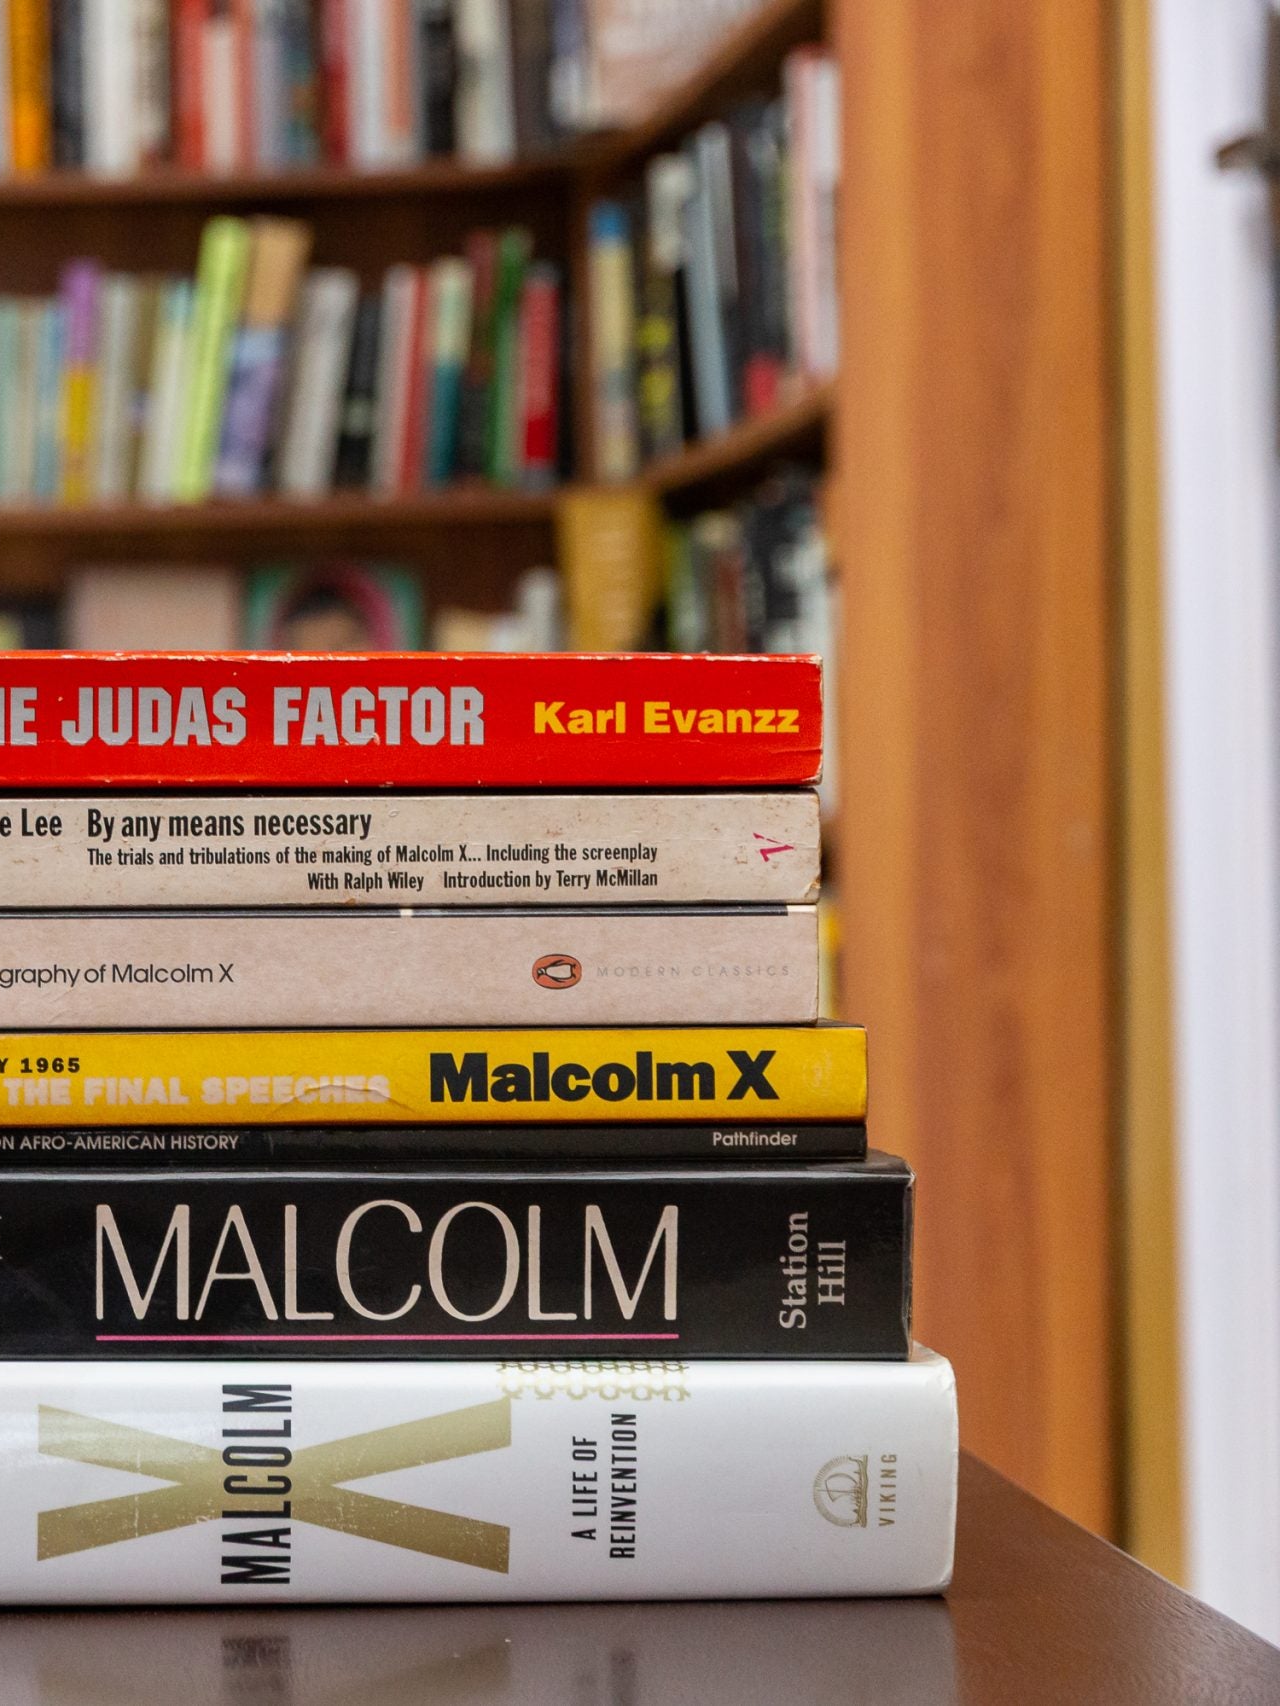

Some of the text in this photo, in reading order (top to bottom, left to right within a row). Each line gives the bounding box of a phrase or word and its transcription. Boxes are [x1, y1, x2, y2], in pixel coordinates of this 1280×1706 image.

[61, 687, 247, 747] JUDAS
[273, 686, 485, 747] FACTOR
[534, 701, 800, 735] Karl Evanzz
[21, 808, 62, 838] Lee
[88, 808, 372, 842] By any means necessary
[88, 849, 112, 866] The
[117, 848, 154, 866] trials
[158, 848, 184, 866] and
[190, 847, 270, 865] tribulations
[275, 848, 290, 865] of
[295, 848, 317, 865] the
[322, 846, 372, 868] making
[377, 846, 391, 863] of
[395, 845, 454, 863] Malcolm
[486, 845, 550, 867] Including
[554, 845, 577, 862] the
[582, 845, 658, 867] screenplay
[307, 872, 424, 894] With Ralph Wiley
[443, 871, 658, 893] Introduction by Terry McMillan
[84, 963, 107, 983] of
[112, 963, 212, 983] Malcolm
[219, 963, 235, 983] X
[596, 965, 790, 977] MODERN CLASSICS
[20, 1057, 81, 1074] 1965
[430, 1050, 780, 1102] Malcolm X
[4, 1075, 391, 1106] THE FINAL SPEECHES
[19, 1135, 166, 1150] AFRO-AMERICAN
[171, 1135, 239, 1150] HISTORY
[713, 1132, 798, 1147] Pathfinder
[96, 1199, 679, 1321] MALCOLM
[779, 1211, 809, 1329] Station
[818, 1240, 846, 1306] Hill
[37, 1399, 511, 1574] X
[221, 1384, 293, 1584] MALCOLM
[572, 1435, 598, 1540] A LIFE OF
[610, 1413, 637, 1559] REINVENTION
[878, 1452, 898, 1527] VIKING
